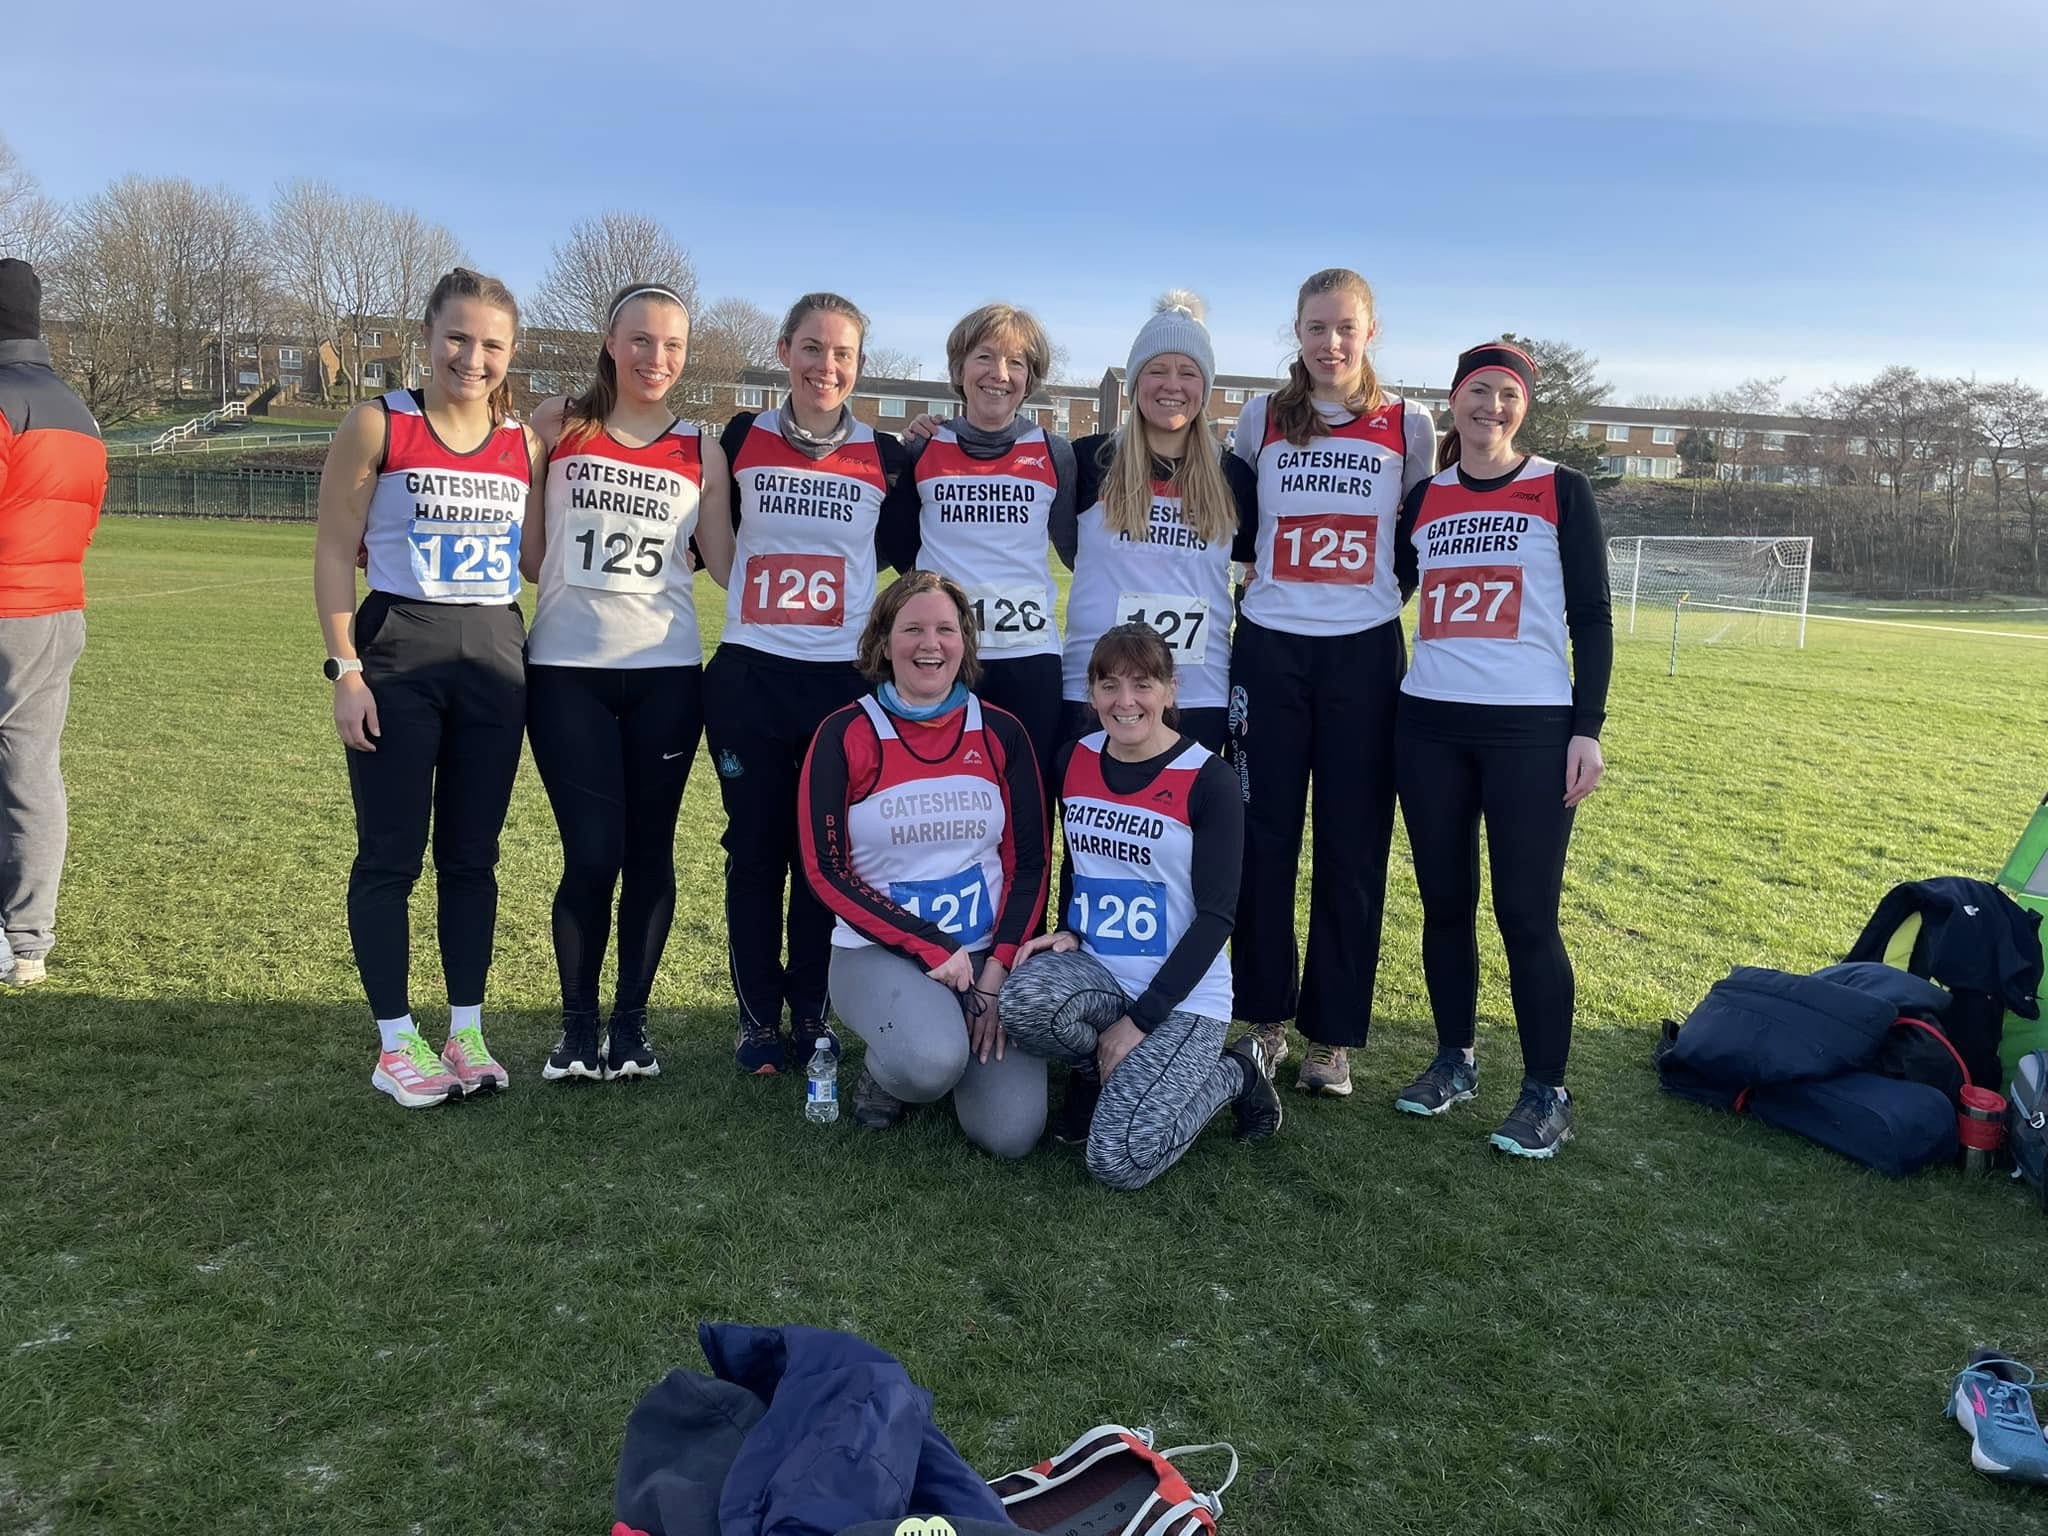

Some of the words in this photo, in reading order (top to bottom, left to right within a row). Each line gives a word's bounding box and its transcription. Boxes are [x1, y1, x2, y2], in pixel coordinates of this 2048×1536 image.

[1277, 451, 1382, 475] GATESHEAD
[405, 472, 521, 503] GATESHEAD
[754, 473, 862, 503] GATESHEAD
[934, 483, 1036, 503] GATESHEAD
[1280, 474, 1373, 498] HARRIERS
[571, 487, 671, 522] HARRIERS
[759, 494, 854, 523] HARRIERS
[940, 504, 1030, 525] HARRIERS
[1426, 516, 1529, 541] GATESHEAD
[419, 534, 512, 581] 125
[575, 529, 664, 578] 125
[1282, 527, 1368, 570] 125
[1428, 534, 1520, 559] HARRIERS
[753, 568, 837, 612] 126
[1427, 581, 1515, 624] 127
[968, 598, 1047, 632] 126
[879, 791, 993, 820] GATESHEAD
[891, 819, 988, 846] HARRIERS
[1066, 803, 1164, 840] GATESHEAD
[1069, 832, 1152, 866] HARRIERS
[1074, 892, 1158, 941] 126
